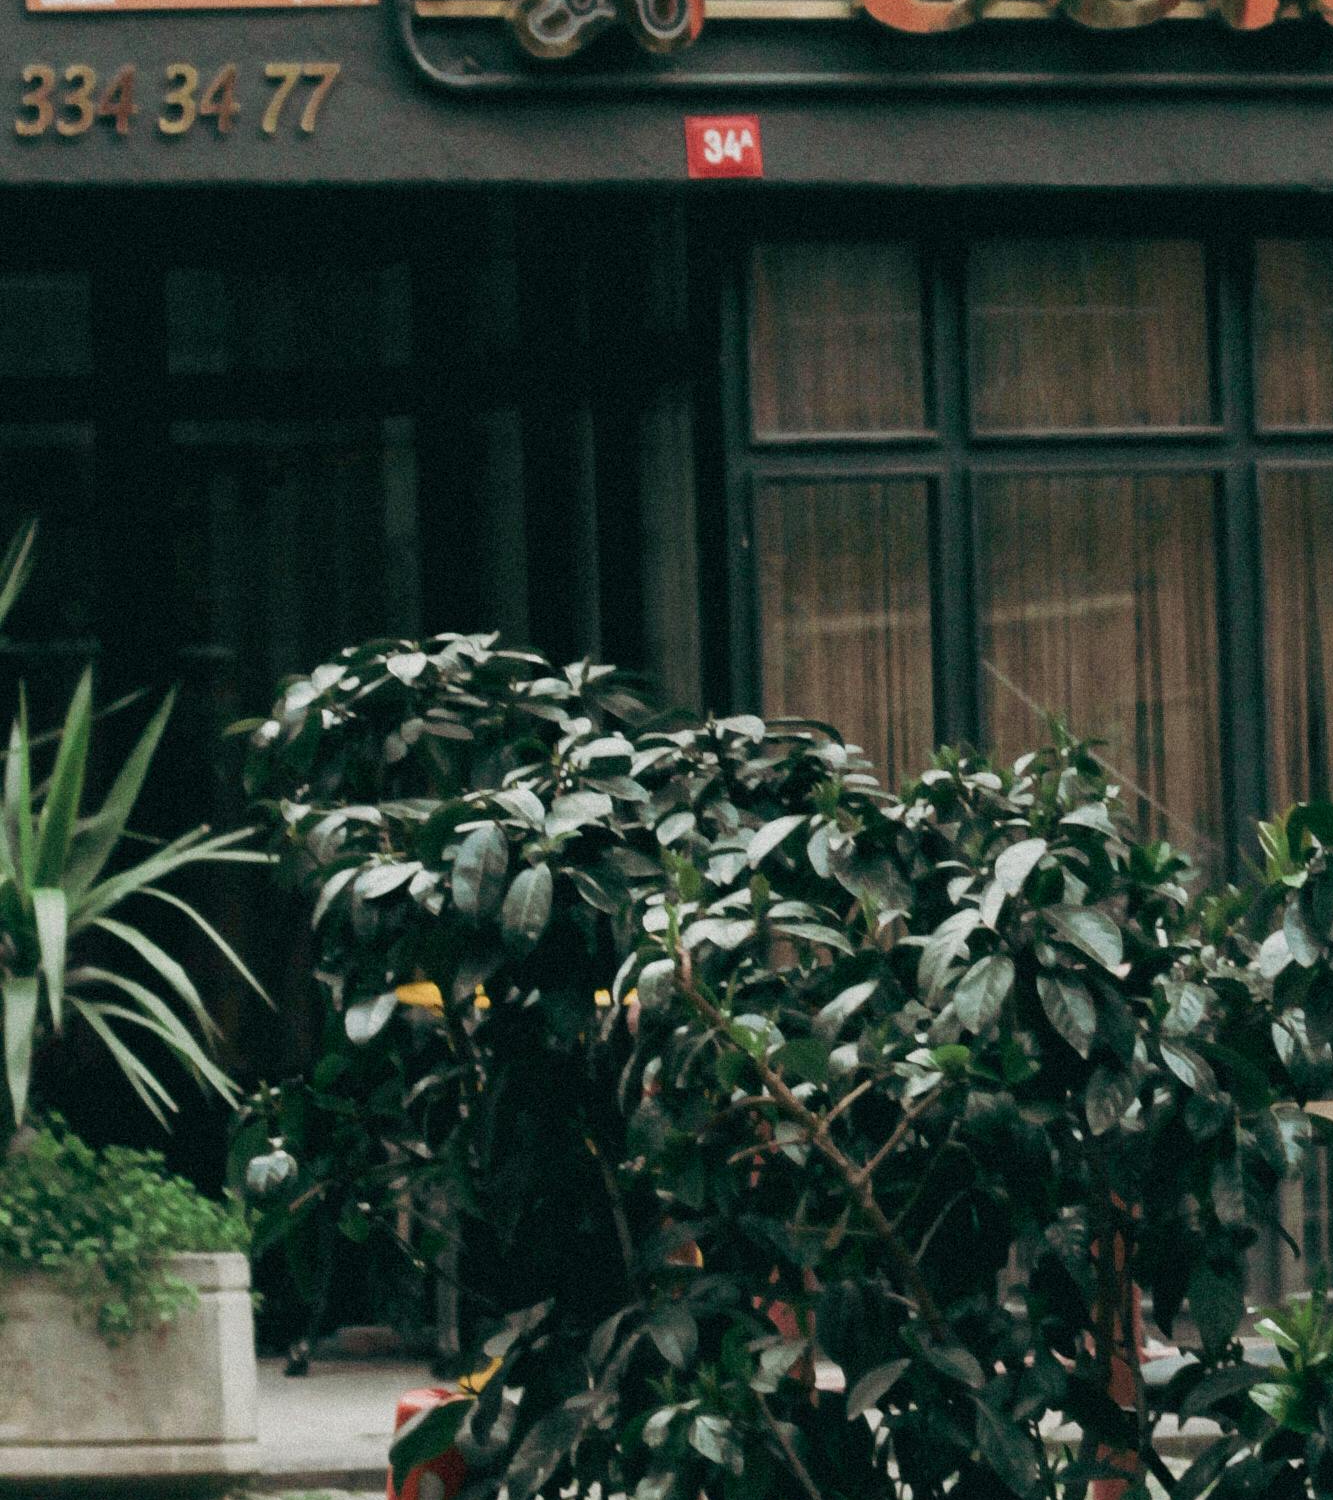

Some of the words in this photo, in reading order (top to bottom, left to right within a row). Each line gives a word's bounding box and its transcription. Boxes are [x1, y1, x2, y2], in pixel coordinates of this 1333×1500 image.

[15, 63, 139, 136] 334
[158, 62, 241, 134] 34
[264, 62, 341, 133] 77
